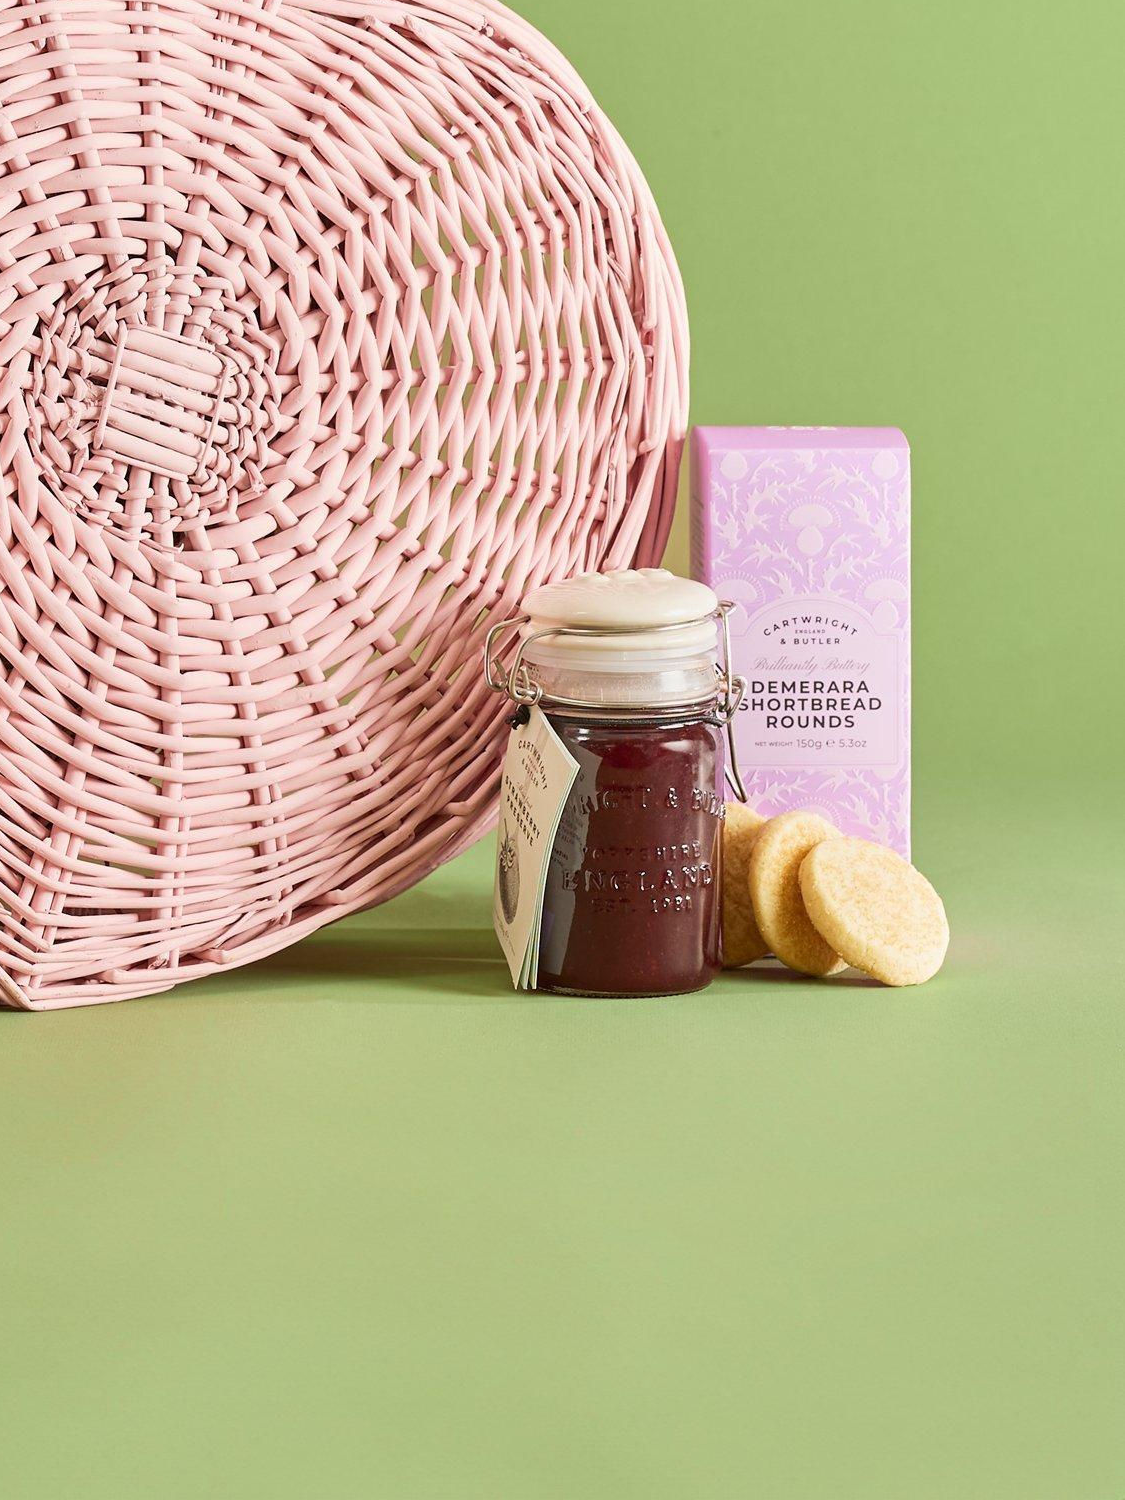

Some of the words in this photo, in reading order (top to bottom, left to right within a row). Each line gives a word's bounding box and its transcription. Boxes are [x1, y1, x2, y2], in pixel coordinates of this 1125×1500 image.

[763, 615, 858, 636] CARTWRIGHT
[793, 637, 841, 645] BUTLER
[750, 656, 818, 675] Brilliantly
[751, 681, 870, 694] DEMERARA
[738, 697, 882, 711] SHORTBREAD
[766, 715, 855, 729] ROUNDS
[796, 739, 823, 750] 150g
[838, 739, 868, 748] 5.3oz
[505, 775, 541, 839] STRAWBERRY
[507, 795, 534, 847] PRESERVE
